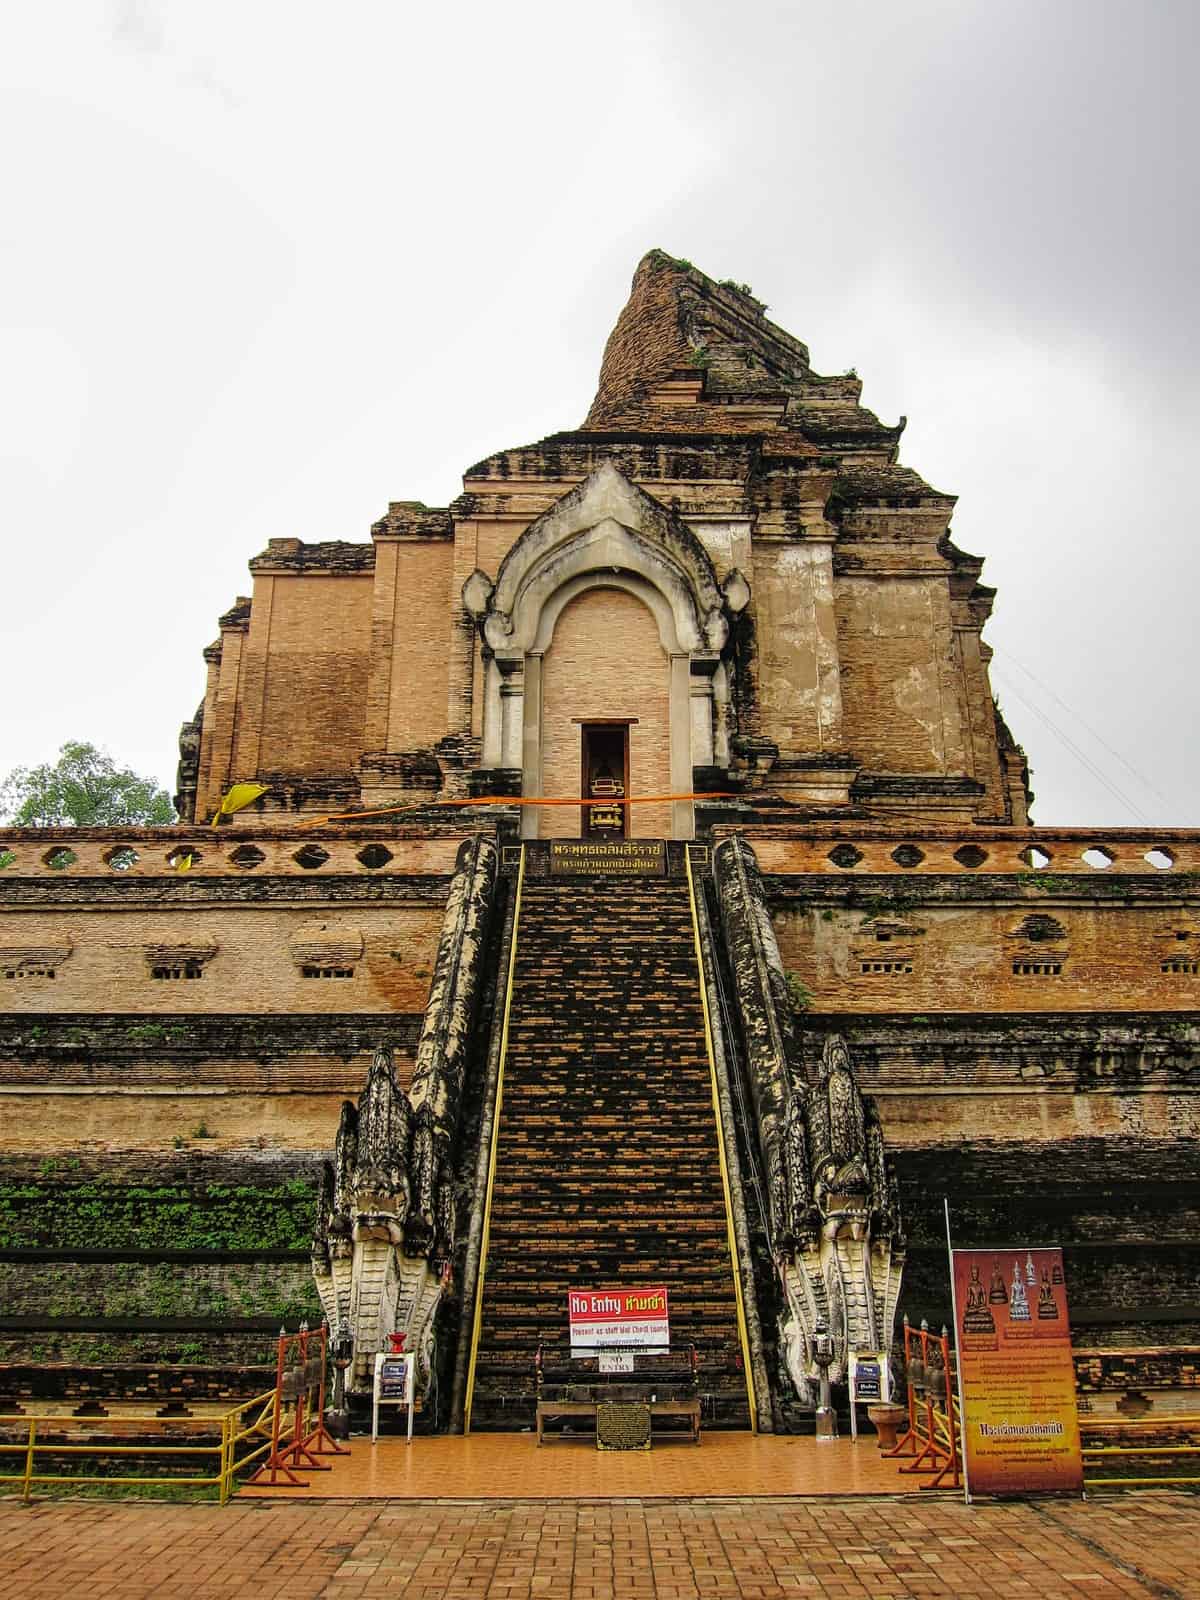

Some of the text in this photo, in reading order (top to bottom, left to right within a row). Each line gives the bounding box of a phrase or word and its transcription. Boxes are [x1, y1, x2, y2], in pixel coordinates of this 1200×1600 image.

[572, 1294, 665, 1315] No Entry ห้ามเข้า
